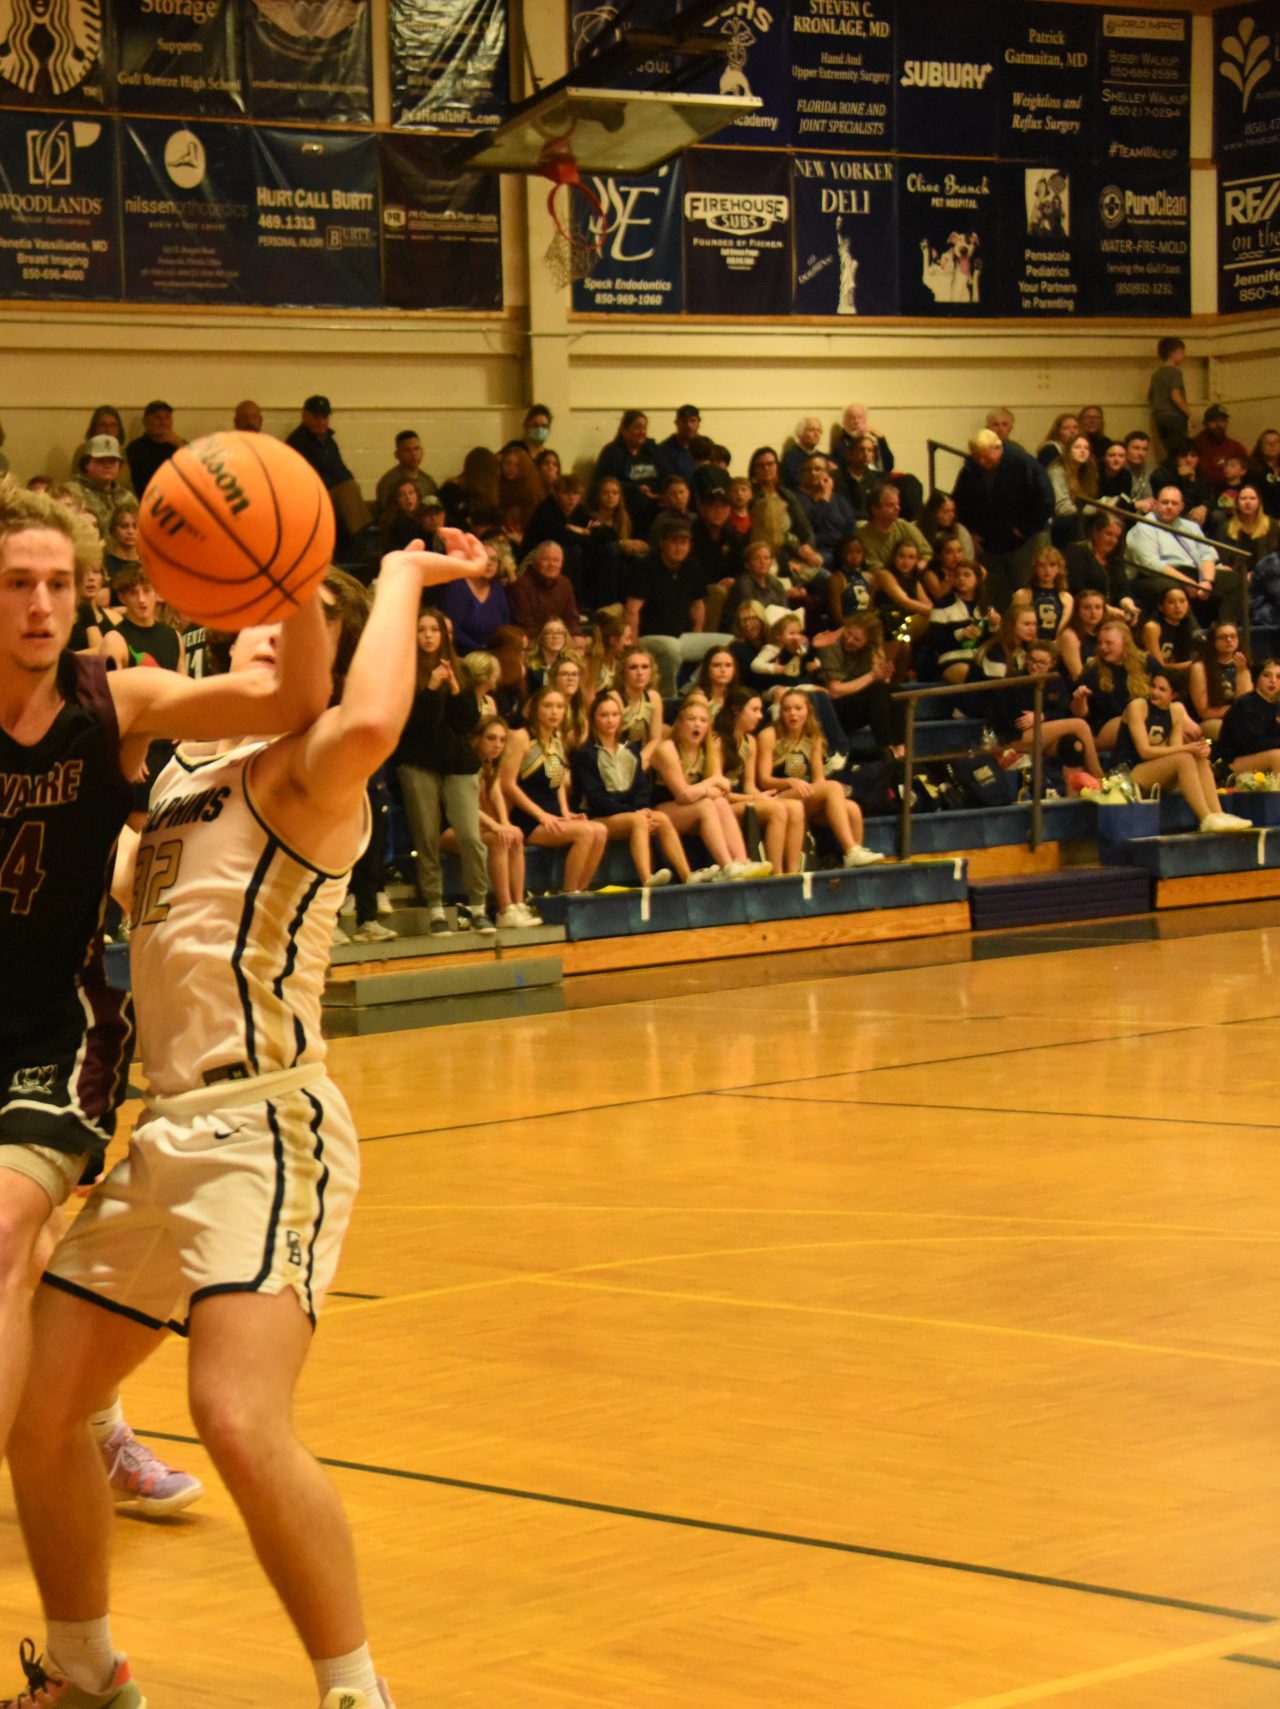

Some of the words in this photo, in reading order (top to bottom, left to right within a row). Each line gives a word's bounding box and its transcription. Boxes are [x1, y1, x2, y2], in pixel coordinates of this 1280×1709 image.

[808, 0, 859, 17] STEVEN
[862, 2, 875, 18] C.
[793, 15, 867, 38] KRONLAGE,
[869, 20, 890, 38] MD
[1028, 27, 1066, 46] Patrick
[1065, 51, 1089, 69] MD
[791, 64, 818, 81] Upper
[818, 67, 859, 83] Extremity
[859, 69, 891, 85] Surgery
[900, 60, 995, 90] SUBWAY
[796, 99, 837, 115] FLORIDA
[838, 101, 866, 116] BONE
[866, 103, 887, 117] AND
[730, 113, 778, 132] cademy
[828, 120, 886, 136] SPECIALISTS
[1044, 115, 1081, 135] Surgery
[793, 158, 826, 178] NEW
[830, 160, 893, 182] YORKER
[294, 188, 330, 210] CALL
[821, 187, 871, 215] DELI
[1124, 188, 1187, 217] PuroClean
[689, 196, 785, 223] FIREHOUSE
[721, 214, 758, 229] SUBS
[583, 277, 612, 292] Speck
[614, 278, 673, 293] Endodontics
